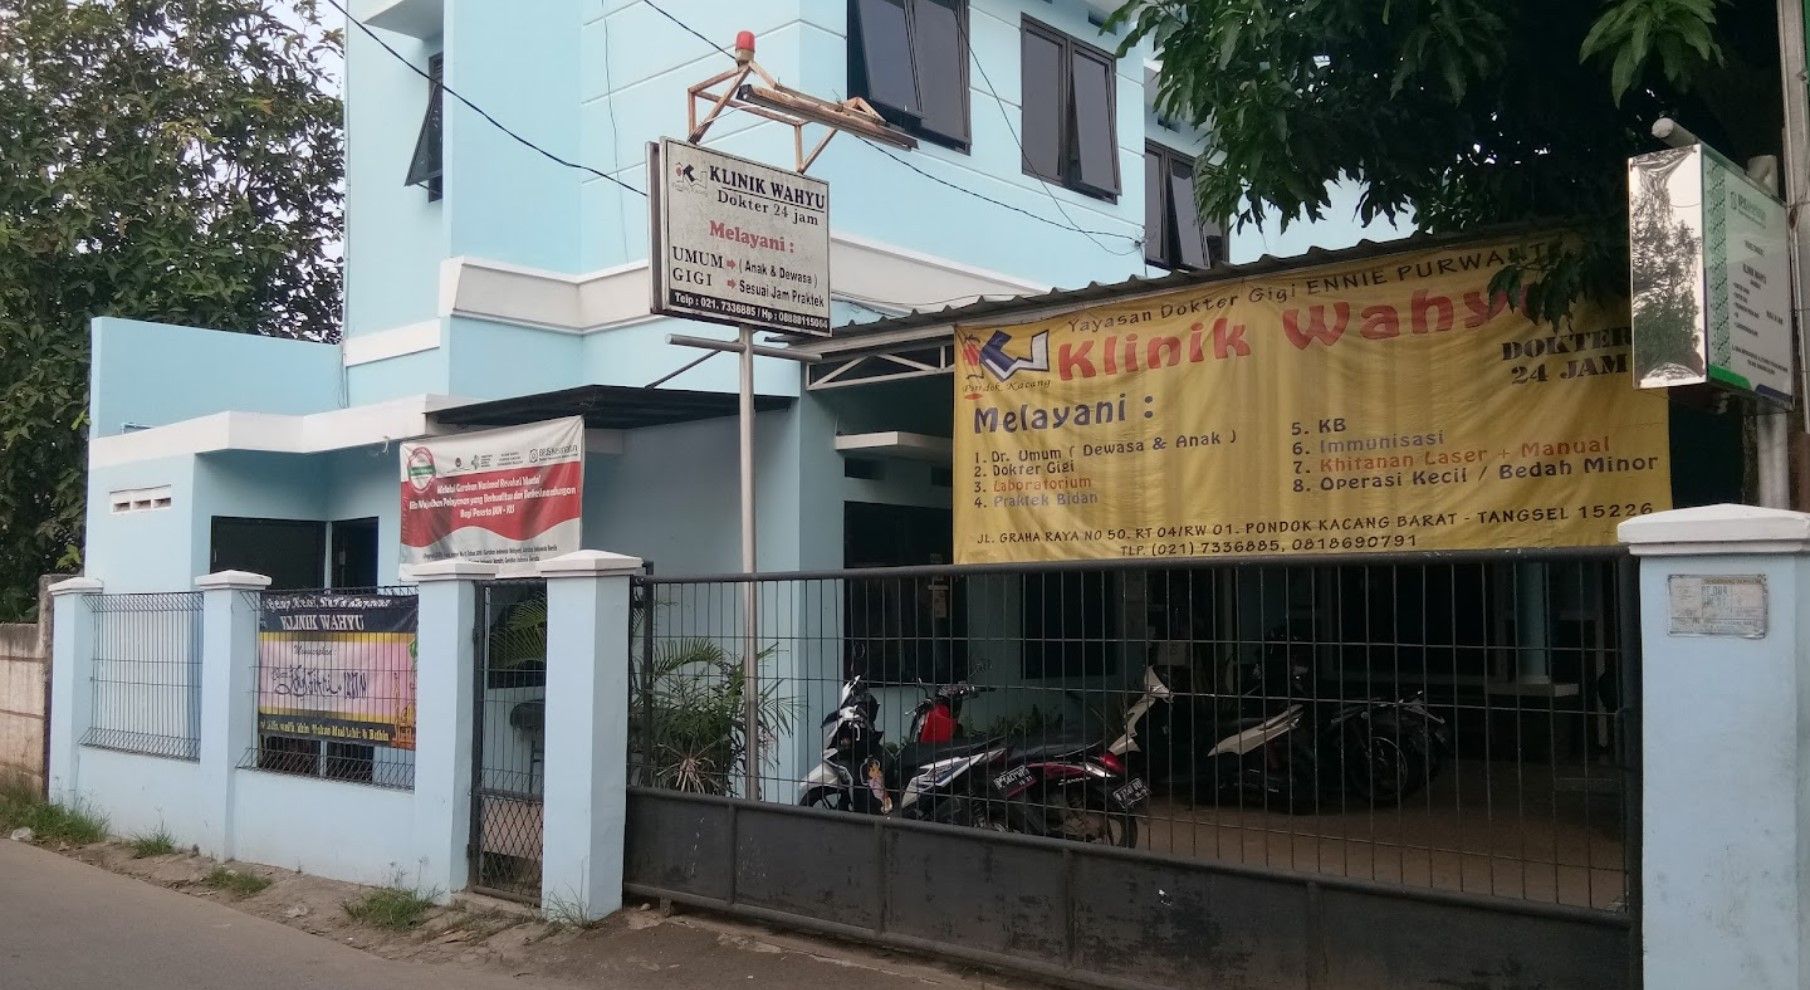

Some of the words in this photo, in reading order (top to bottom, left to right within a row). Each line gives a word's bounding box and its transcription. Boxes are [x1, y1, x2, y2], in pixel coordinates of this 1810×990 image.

[709, 165, 767, 195] KLINIK
[770, 182, 825, 210] WAHYU
[717, 190, 769, 213] Dokter
[773, 203, 789, 218] 24
[793, 208, 819, 226] jam
[709, 220, 785, 252] Melayani
[672, 246, 724, 269] UMUM
[779, 267, 813, 285] Dewasa
[672, 267, 712, 286] GIGI
[739, 280, 769, 297] Sesuai
[771, 286, 790, 300] Jam
[792, 289, 825, 308] Praktek
[1068, 310, 1152, 333] Yayasan
[1160, 295, 1239, 319] Dokter
[1249, 283, 1296, 304] Gigi
[1307, 270, 1388, 296] ENNIE
[1058, 316, 1251, 381] Klinik
[1502, 326, 1632, 361] DOKTER
[1511, 363, 1549, 385] 24
[1559, 353, 1628, 380] JAM
[974, 393, 1126, 434] Melayani
[1291, 421, 1310, 436] 5.
[1318, 418, 1347, 434] KB
[992, 451, 1010, 463] Dr.
[1019, 449, 1061, 461] Umum
[1083, 440, 1145, 457] Dewasa
[1152, 436, 1168, 451] &
[1176, 431, 1222, 449] Anak
[1292, 441, 1311, 456] 6.
[1320, 430, 1445, 454] Immunisasi
[1292, 460, 1311, 475] 7.
[1320, 454, 1414, 473] Khitanan
[1424, 448, 1488, 467] Laser
[1521, 435, 1610, 459] Manual
[974, 466, 987, 478] 2.
[993, 464, 1041, 477] Dokter
[1046, 459, 1075, 474] Gigi
[974, 481, 987, 493] 3.
[993, 476, 1092, 493] Laboratorium
[1292, 479, 1311, 493] 8.
[1320, 471, 1402, 492] Operasi
[1412, 467, 1467, 486] Kecil
[1499, 459, 1572, 480] Bedah
[1584, 456, 1659, 474] Minor
[974, 497, 987, 509] 4.
[994, 493, 1049, 508] Praktek
[1056, 492, 1098, 506] Bidan
[977, 535, 995, 545] JL.
[1000, 532, 1041, 544] GRAHA
[1045, 530, 1080, 543] RAYA
[1084, 530, 1102, 541] NO
[1135, 527, 1152, 540] RT
[1246, 520, 1312, 534] PONDOK
[1318, 516, 1390, 531] KACANG
[1397, 513, 1458, 528] BARAT
[1477, 507, 1569, 524] TANGSEL
[1578, 502, 1653, 519] 15226
[1120, 545, 1146, 557] TLP.
[1151, 541, 1194, 557] (021)
[1201, 540, 1286, 553] 7336885,
[1291, 534, 1416, 551] 0818690791
[280, 614, 318, 631] KLINIK
[319, 614, 364, 631] WAHYU
